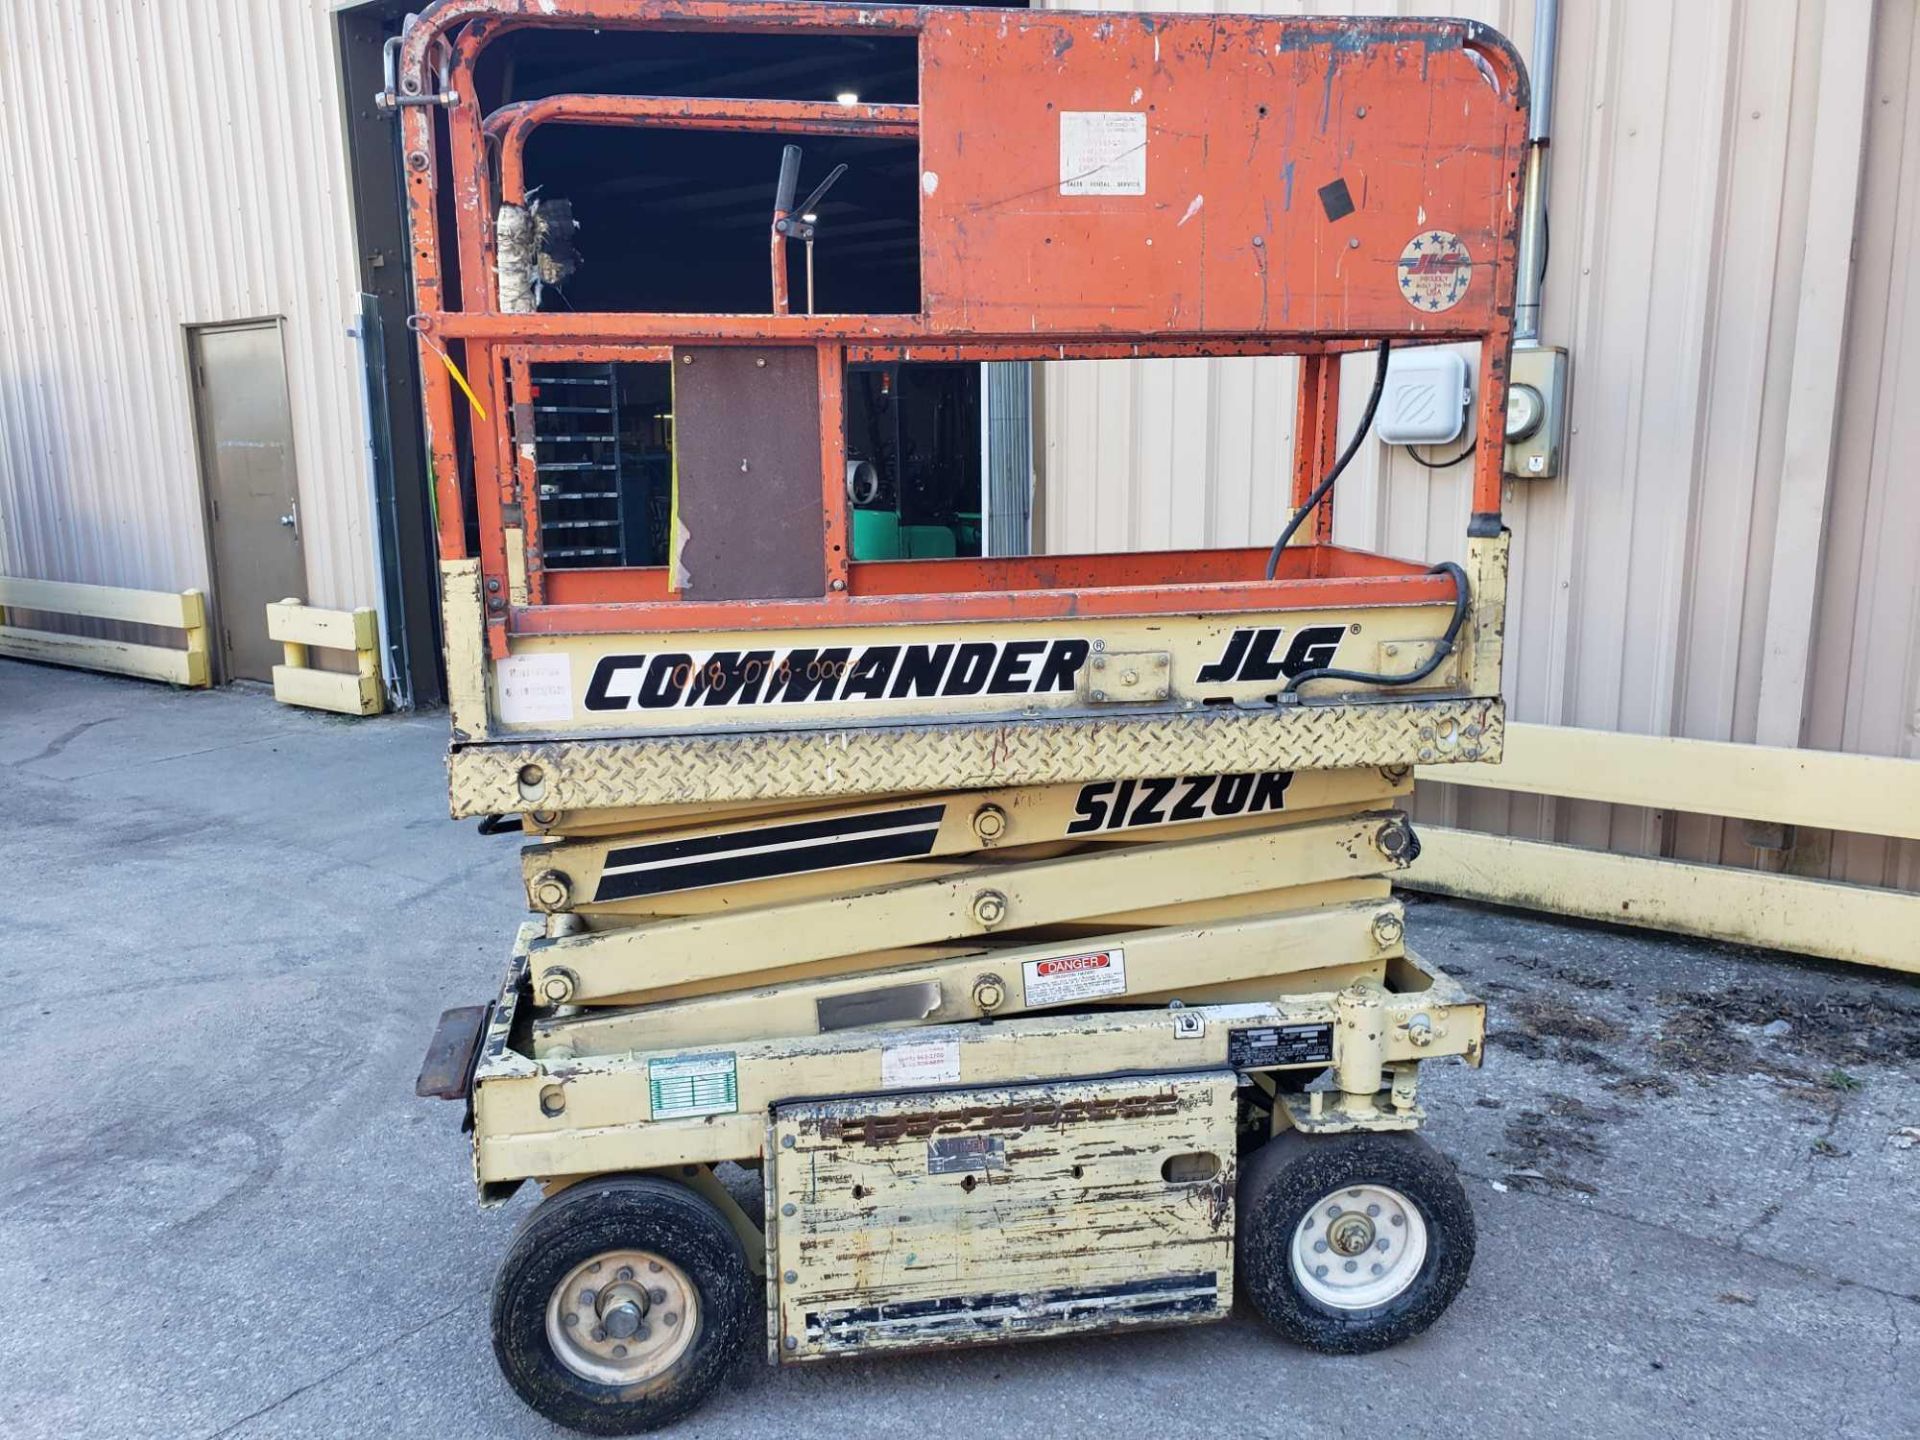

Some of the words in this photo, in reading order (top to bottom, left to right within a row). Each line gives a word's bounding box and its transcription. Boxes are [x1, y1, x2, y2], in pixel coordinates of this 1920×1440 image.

[584, 638, 1090, 711] COMMANDER
[1195, 626, 1347, 684] JLG
[1066, 770, 1295, 835] SIZZOR
[1048, 956, 1100, 974] DANGER
